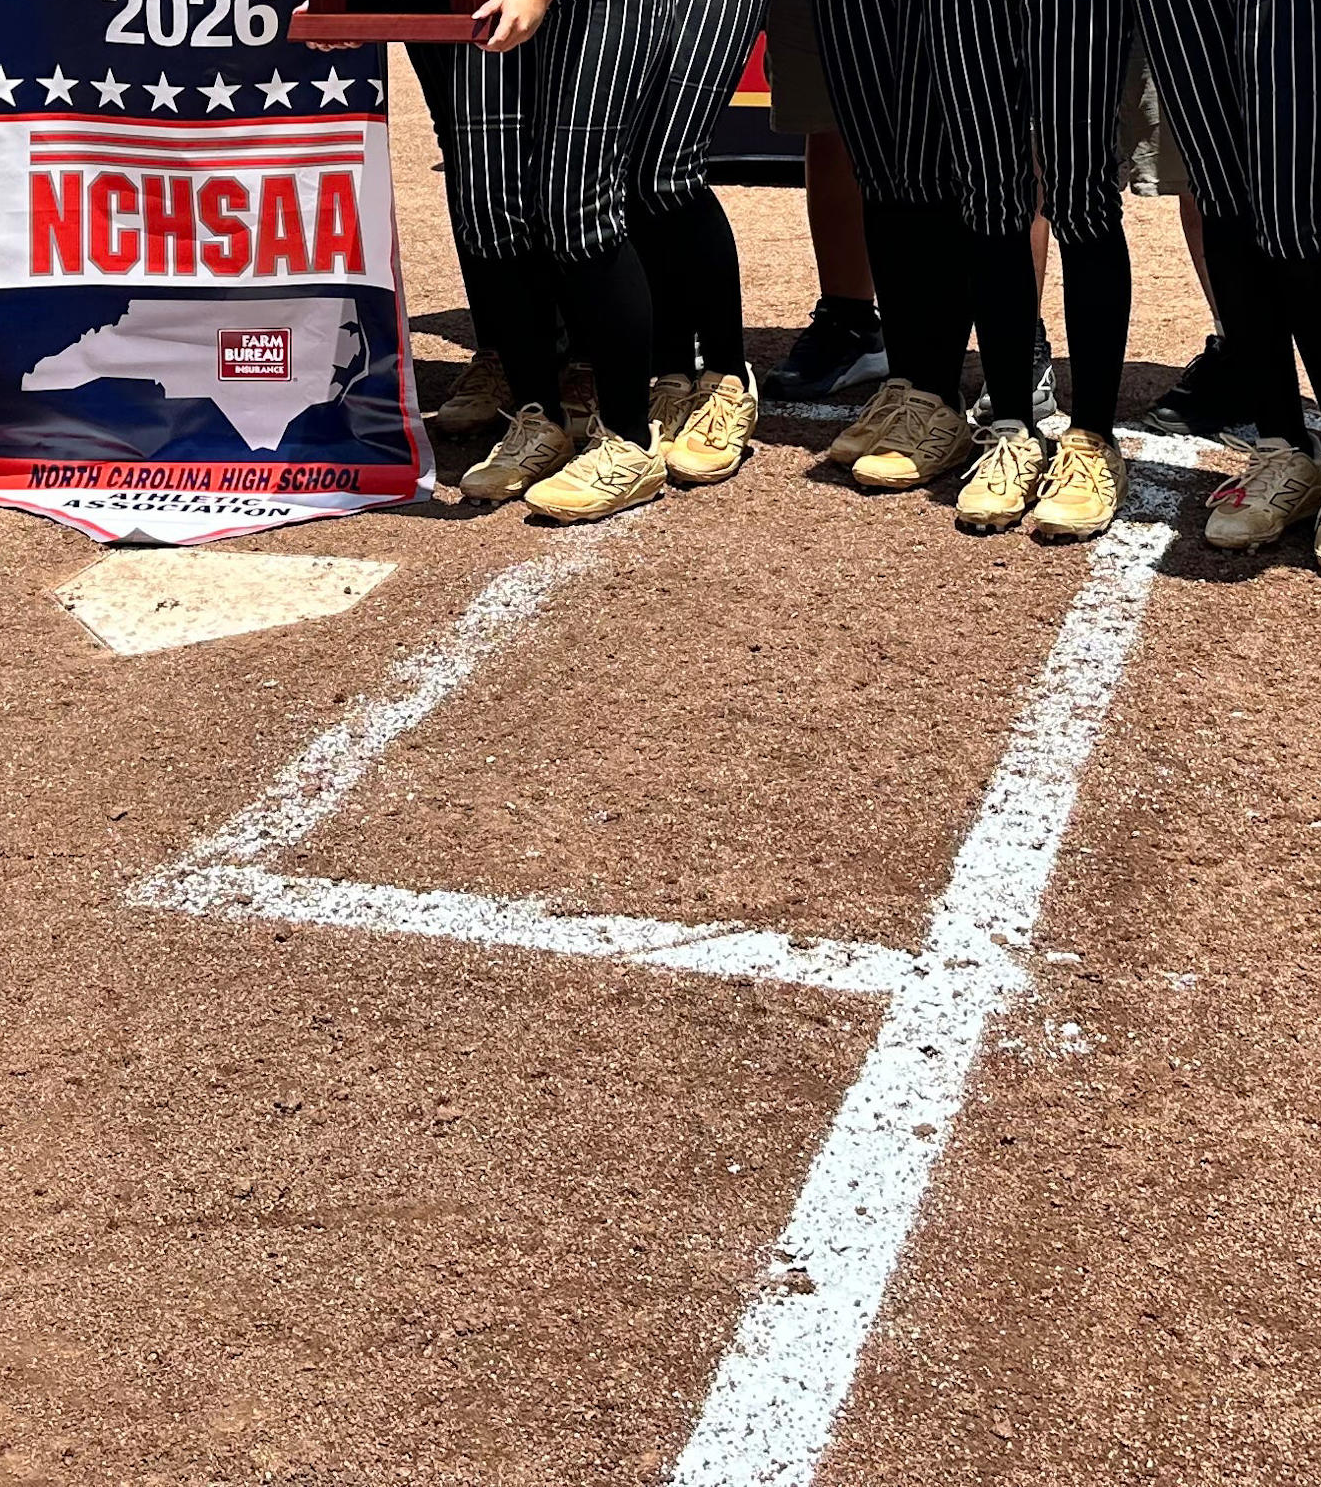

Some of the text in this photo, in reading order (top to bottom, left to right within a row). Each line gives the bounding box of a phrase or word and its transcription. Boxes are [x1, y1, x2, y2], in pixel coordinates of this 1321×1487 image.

[29, 170, 365, 277] NCHSAA
[242, 335, 284, 348] FARM
[224, 348, 284, 362] BUREAU
[235, 366, 284, 374] INSURANCE
[29, 464, 361, 491] NORTH CAROLINA HIGH SCHOOL
[108, 492, 262, 506] ATHLETIC
[63, 499, 292, 517] ASSOCIATION
